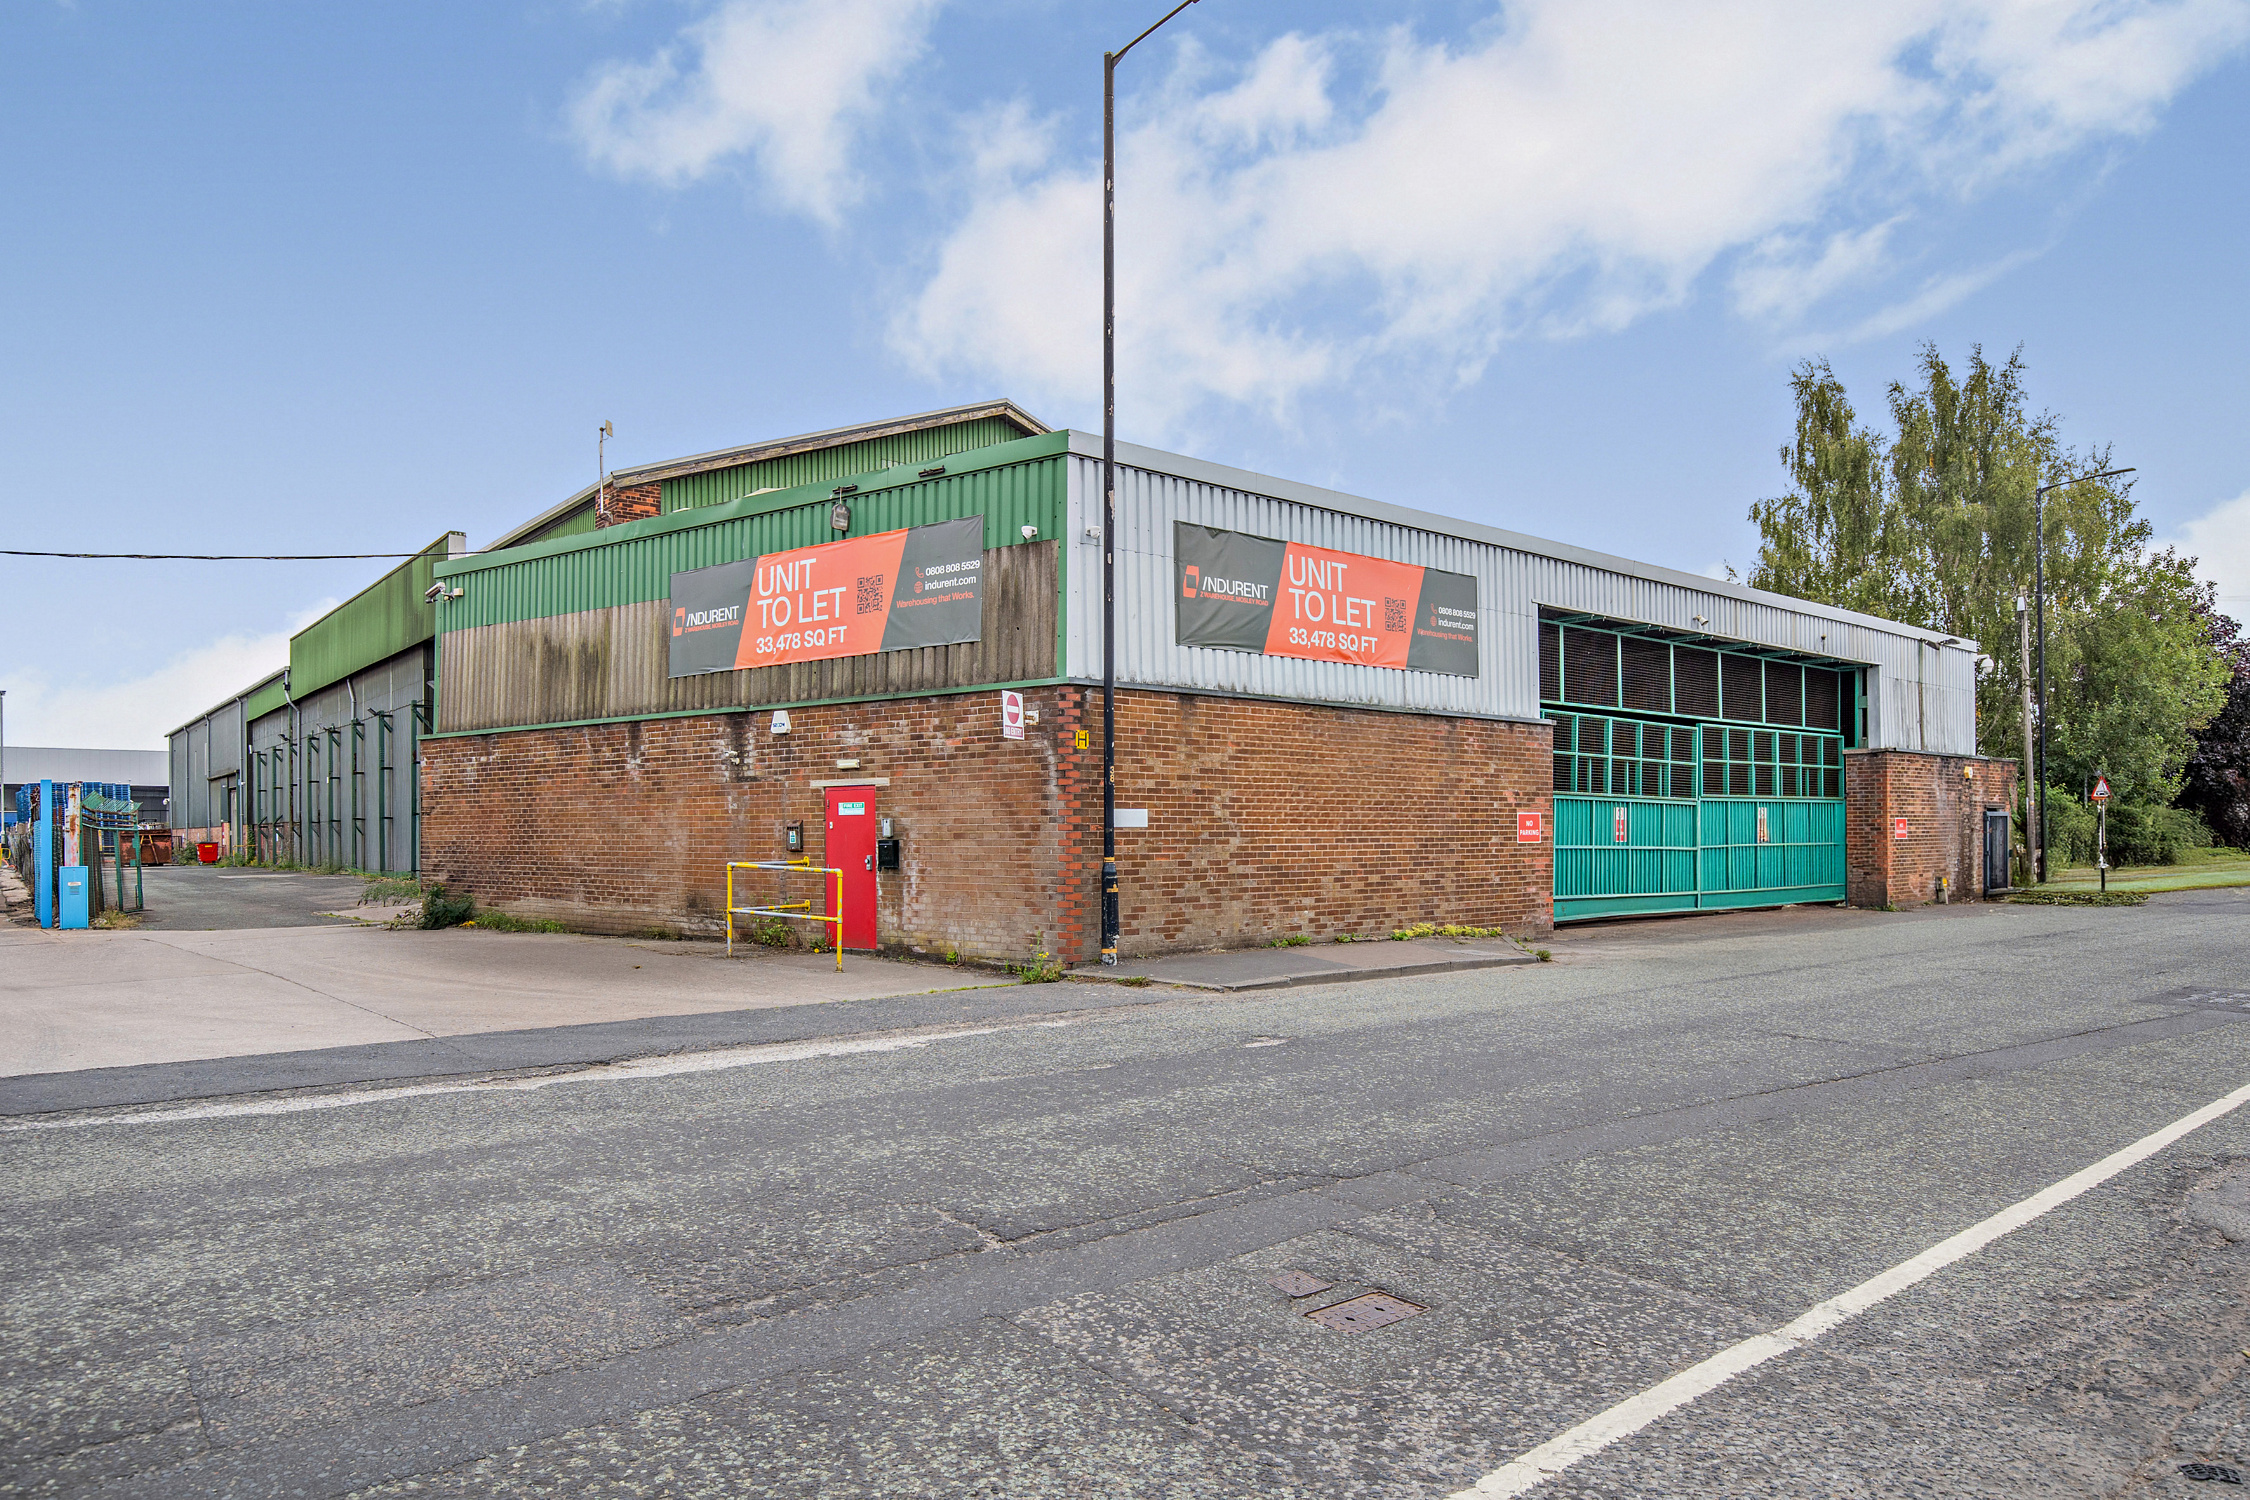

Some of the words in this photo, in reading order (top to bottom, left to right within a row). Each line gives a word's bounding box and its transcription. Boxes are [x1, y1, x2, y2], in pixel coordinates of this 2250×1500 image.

[758, 557, 817, 597] UNIT
[925, 565, 945, 577] 0808
[945, 562, 961, 573] 808
[961, 559, 981, 571] 5529
[1288, 554, 1348, 592] UNIT
[924, 575, 977, 591] indurent.com
[1202, 576, 1269, 600] INDURENT
[756, 596, 792, 629] TO
[798, 586, 847, 624] LET
[896, 596, 938, 609] Warehousing
[938, 593, 951, 603] that
[951, 590, 975, 601] Works.
[1200, 590, 1204, 598] Z
[1235, 596, 1255, 605] MOSLEY
[1288, 587, 1325, 622] TO
[1332, 594, 1376, 629] LET
[686, 605, 740, 628] INDURENT
[1437, 617, 1475, 631] indurent.com
[1438, 606, 1452, 616] 0808
[1452, 608, 1463, 618] 808
[1463, 611, 1476, 619] 5529
[756, 632, 801, 655] 33,478
[803, 628, 826, 648] SQ
[828, 625, 848, 645] FT
[1289, 626, 1336, 649] 33,478
[1338, 632, 1359, 652] SQ
[1361, 635, 1378, 654] FT
[1416, 627, 1448, 641] Warehousing
[1447, 632, 1457, 640] that
